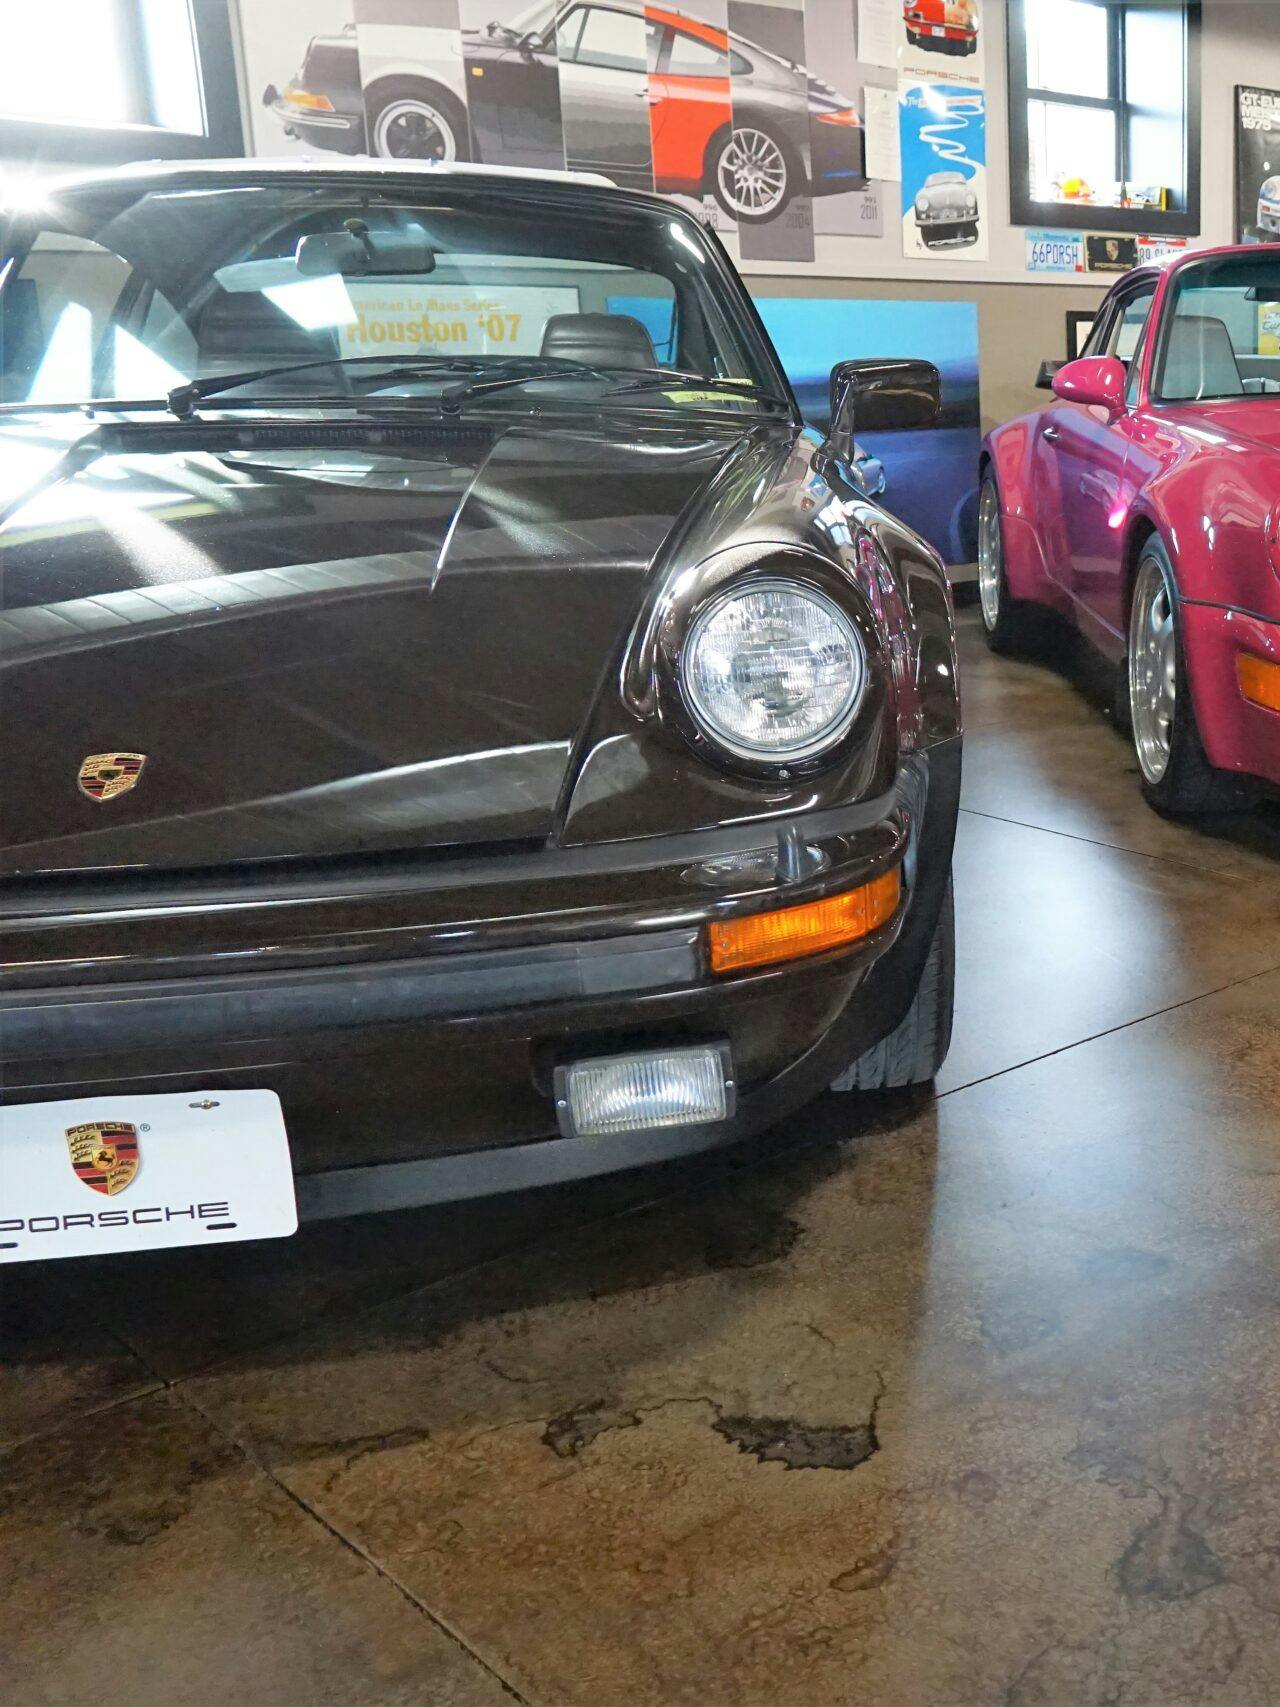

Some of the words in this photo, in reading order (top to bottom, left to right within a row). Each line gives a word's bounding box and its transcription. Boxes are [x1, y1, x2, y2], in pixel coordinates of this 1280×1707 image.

[1242, 117, 1272, 131] 1975
[860, 204, 878, 220] 2011
[346, 312, 468, 343] Houston
[67, 1121, 135, 1136] PORSCHE
[0, 1201, 230, 1233] PORSCHE
